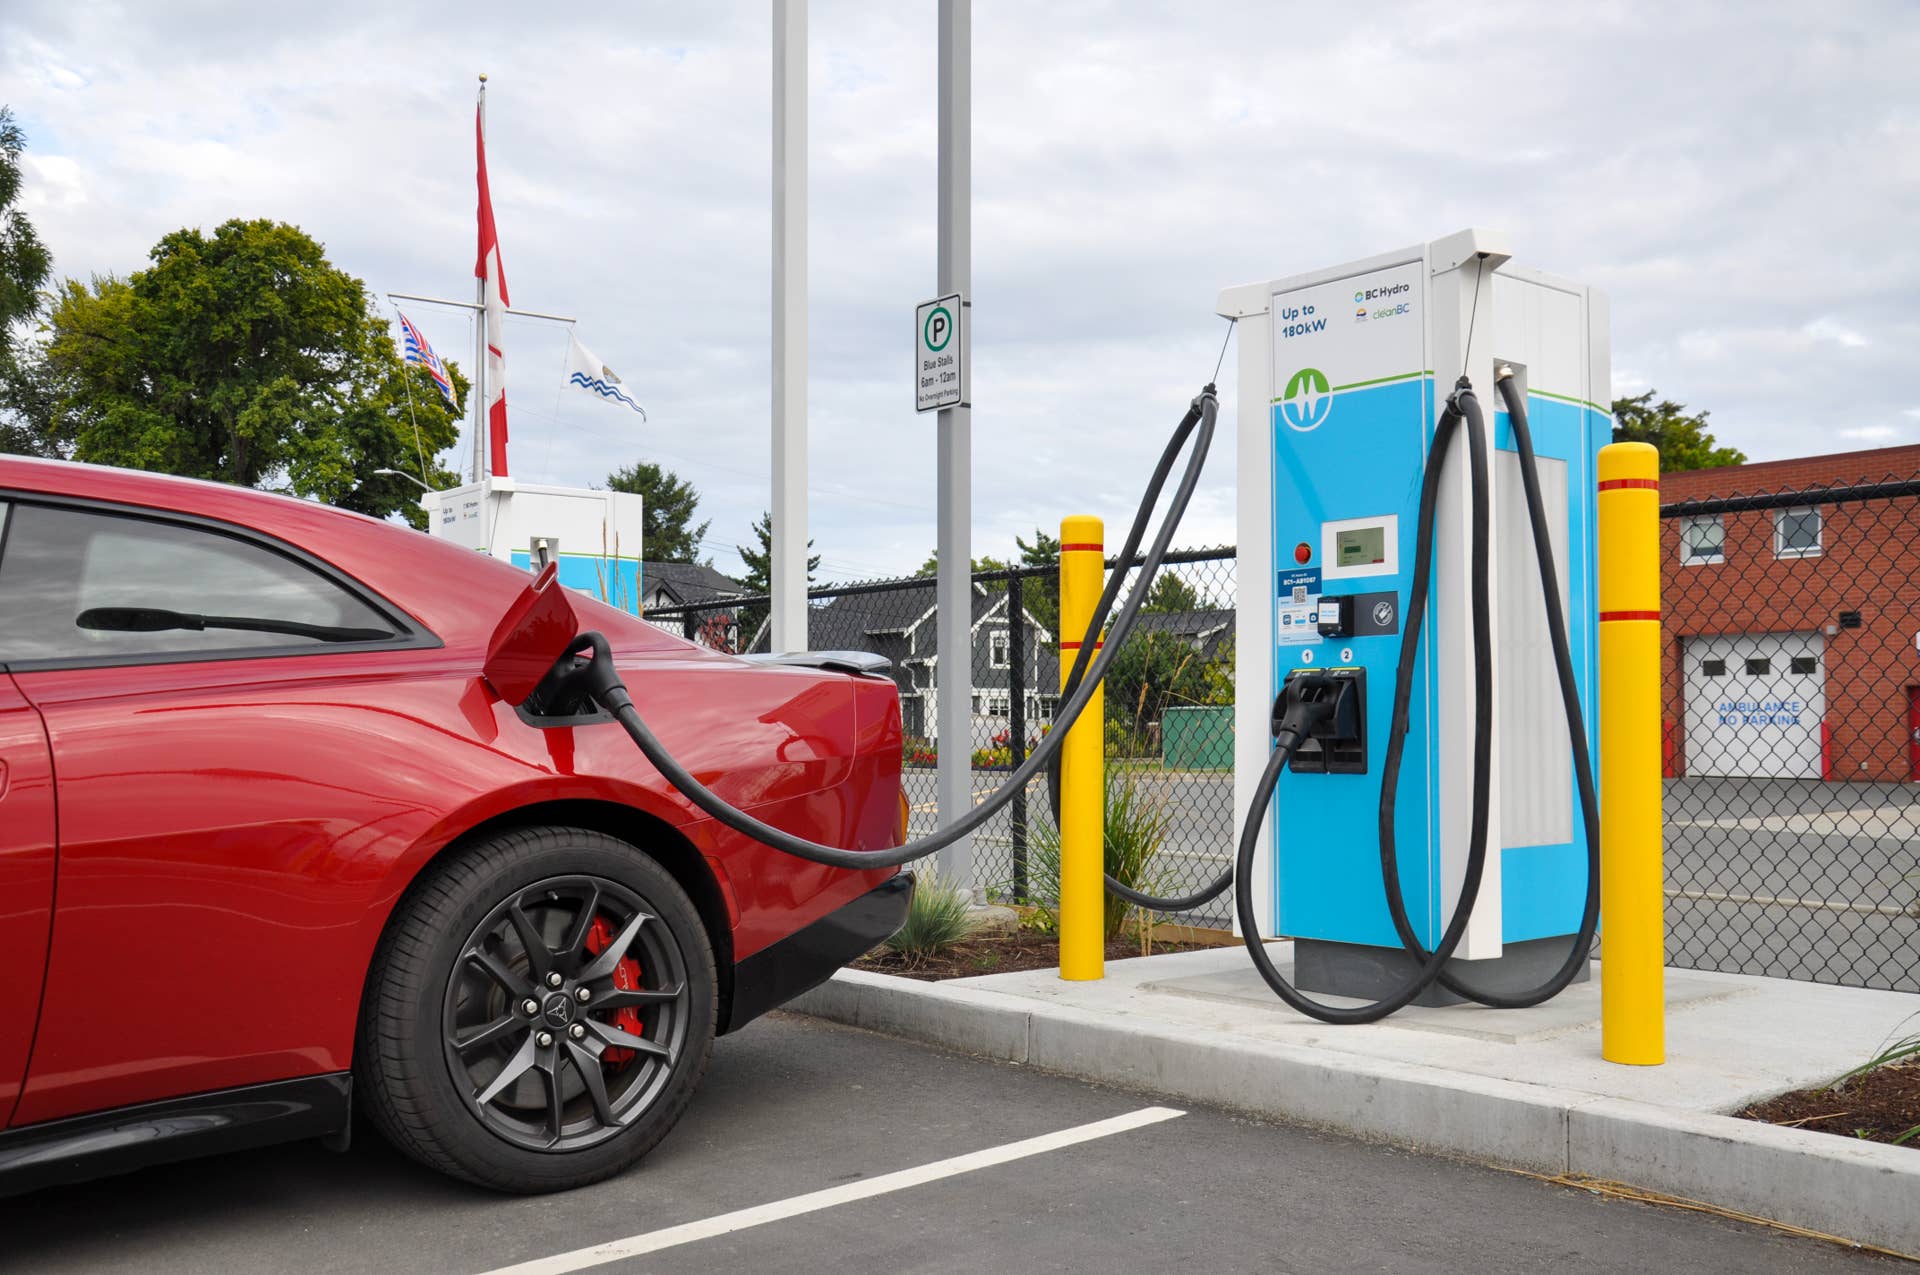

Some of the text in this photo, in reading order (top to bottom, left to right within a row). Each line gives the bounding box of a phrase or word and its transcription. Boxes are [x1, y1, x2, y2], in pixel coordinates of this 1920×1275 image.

[1365, 284, 1410, 300] BC Hydro
[1282, 304, 1315, 321] Up to
[1372, 302, 1410, 320] cleanBC
[934, 318, 945, 342] P
[1282, 318, 1327, 338] 180kW
[924, 354, 953, 371] Blue Stalls
[921, 376, 934, 388] 6am
[939, 371, 956, 384] 12am
[1305, 652, 1309, 661] 1
[1344, 650, 1349, 660] 2
